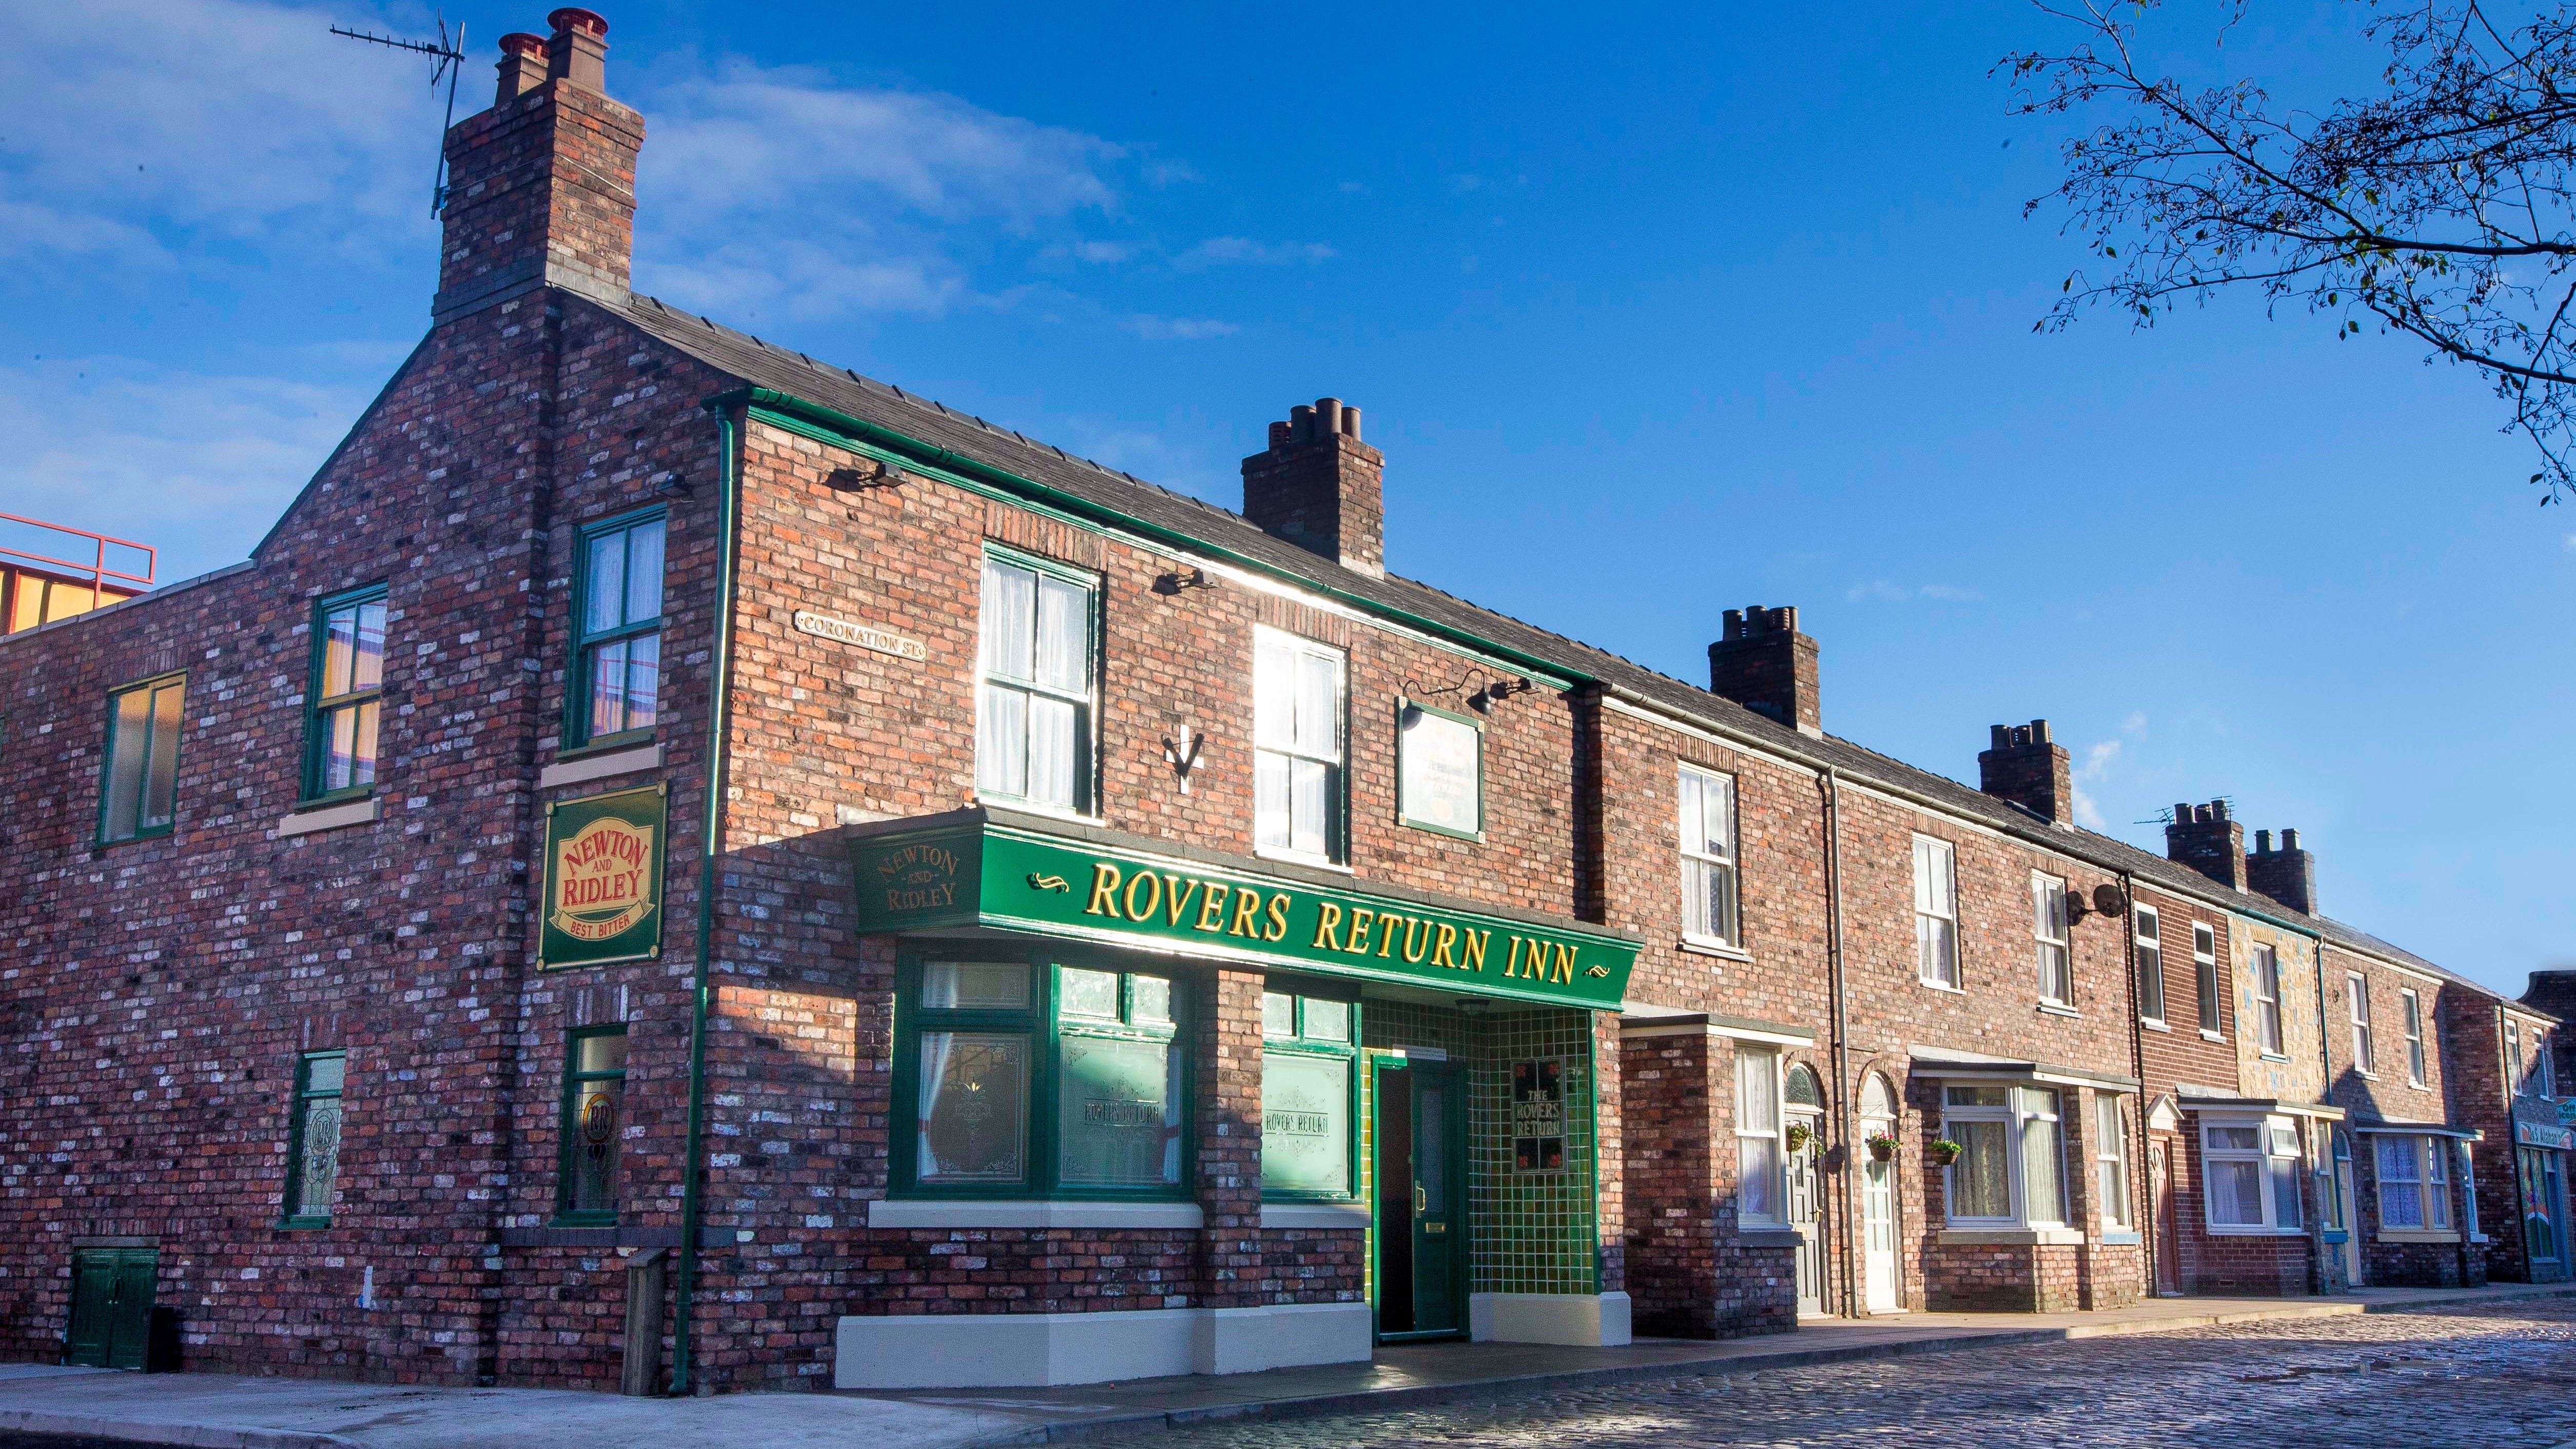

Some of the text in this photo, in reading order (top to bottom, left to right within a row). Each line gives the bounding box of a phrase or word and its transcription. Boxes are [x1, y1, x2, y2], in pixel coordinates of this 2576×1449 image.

[804, 616, 899, 652] CORONATION
[564, 829, 648, 877] NEWTON
[878, 845, 960, 876] NEWTON
[592, 858, 612, 872] AND
[563, 869, 643, 907] RIDLEY
[909, 871, 932, 884] AND
[887, 883, 956, 910] RIDLEY
[570, 914, 630, 937] BEST BITTER
[1084, 863, 1579, 985] ROVERS RETURN INN
[1527, 1090, 1548, 1101] THE
[1266, 1113, 1328, 1133] ROVERS RETURN
[1517, 1103, 1560, 1120] ROVERS
[1517, 1120, 1560, 1137] RETURN
